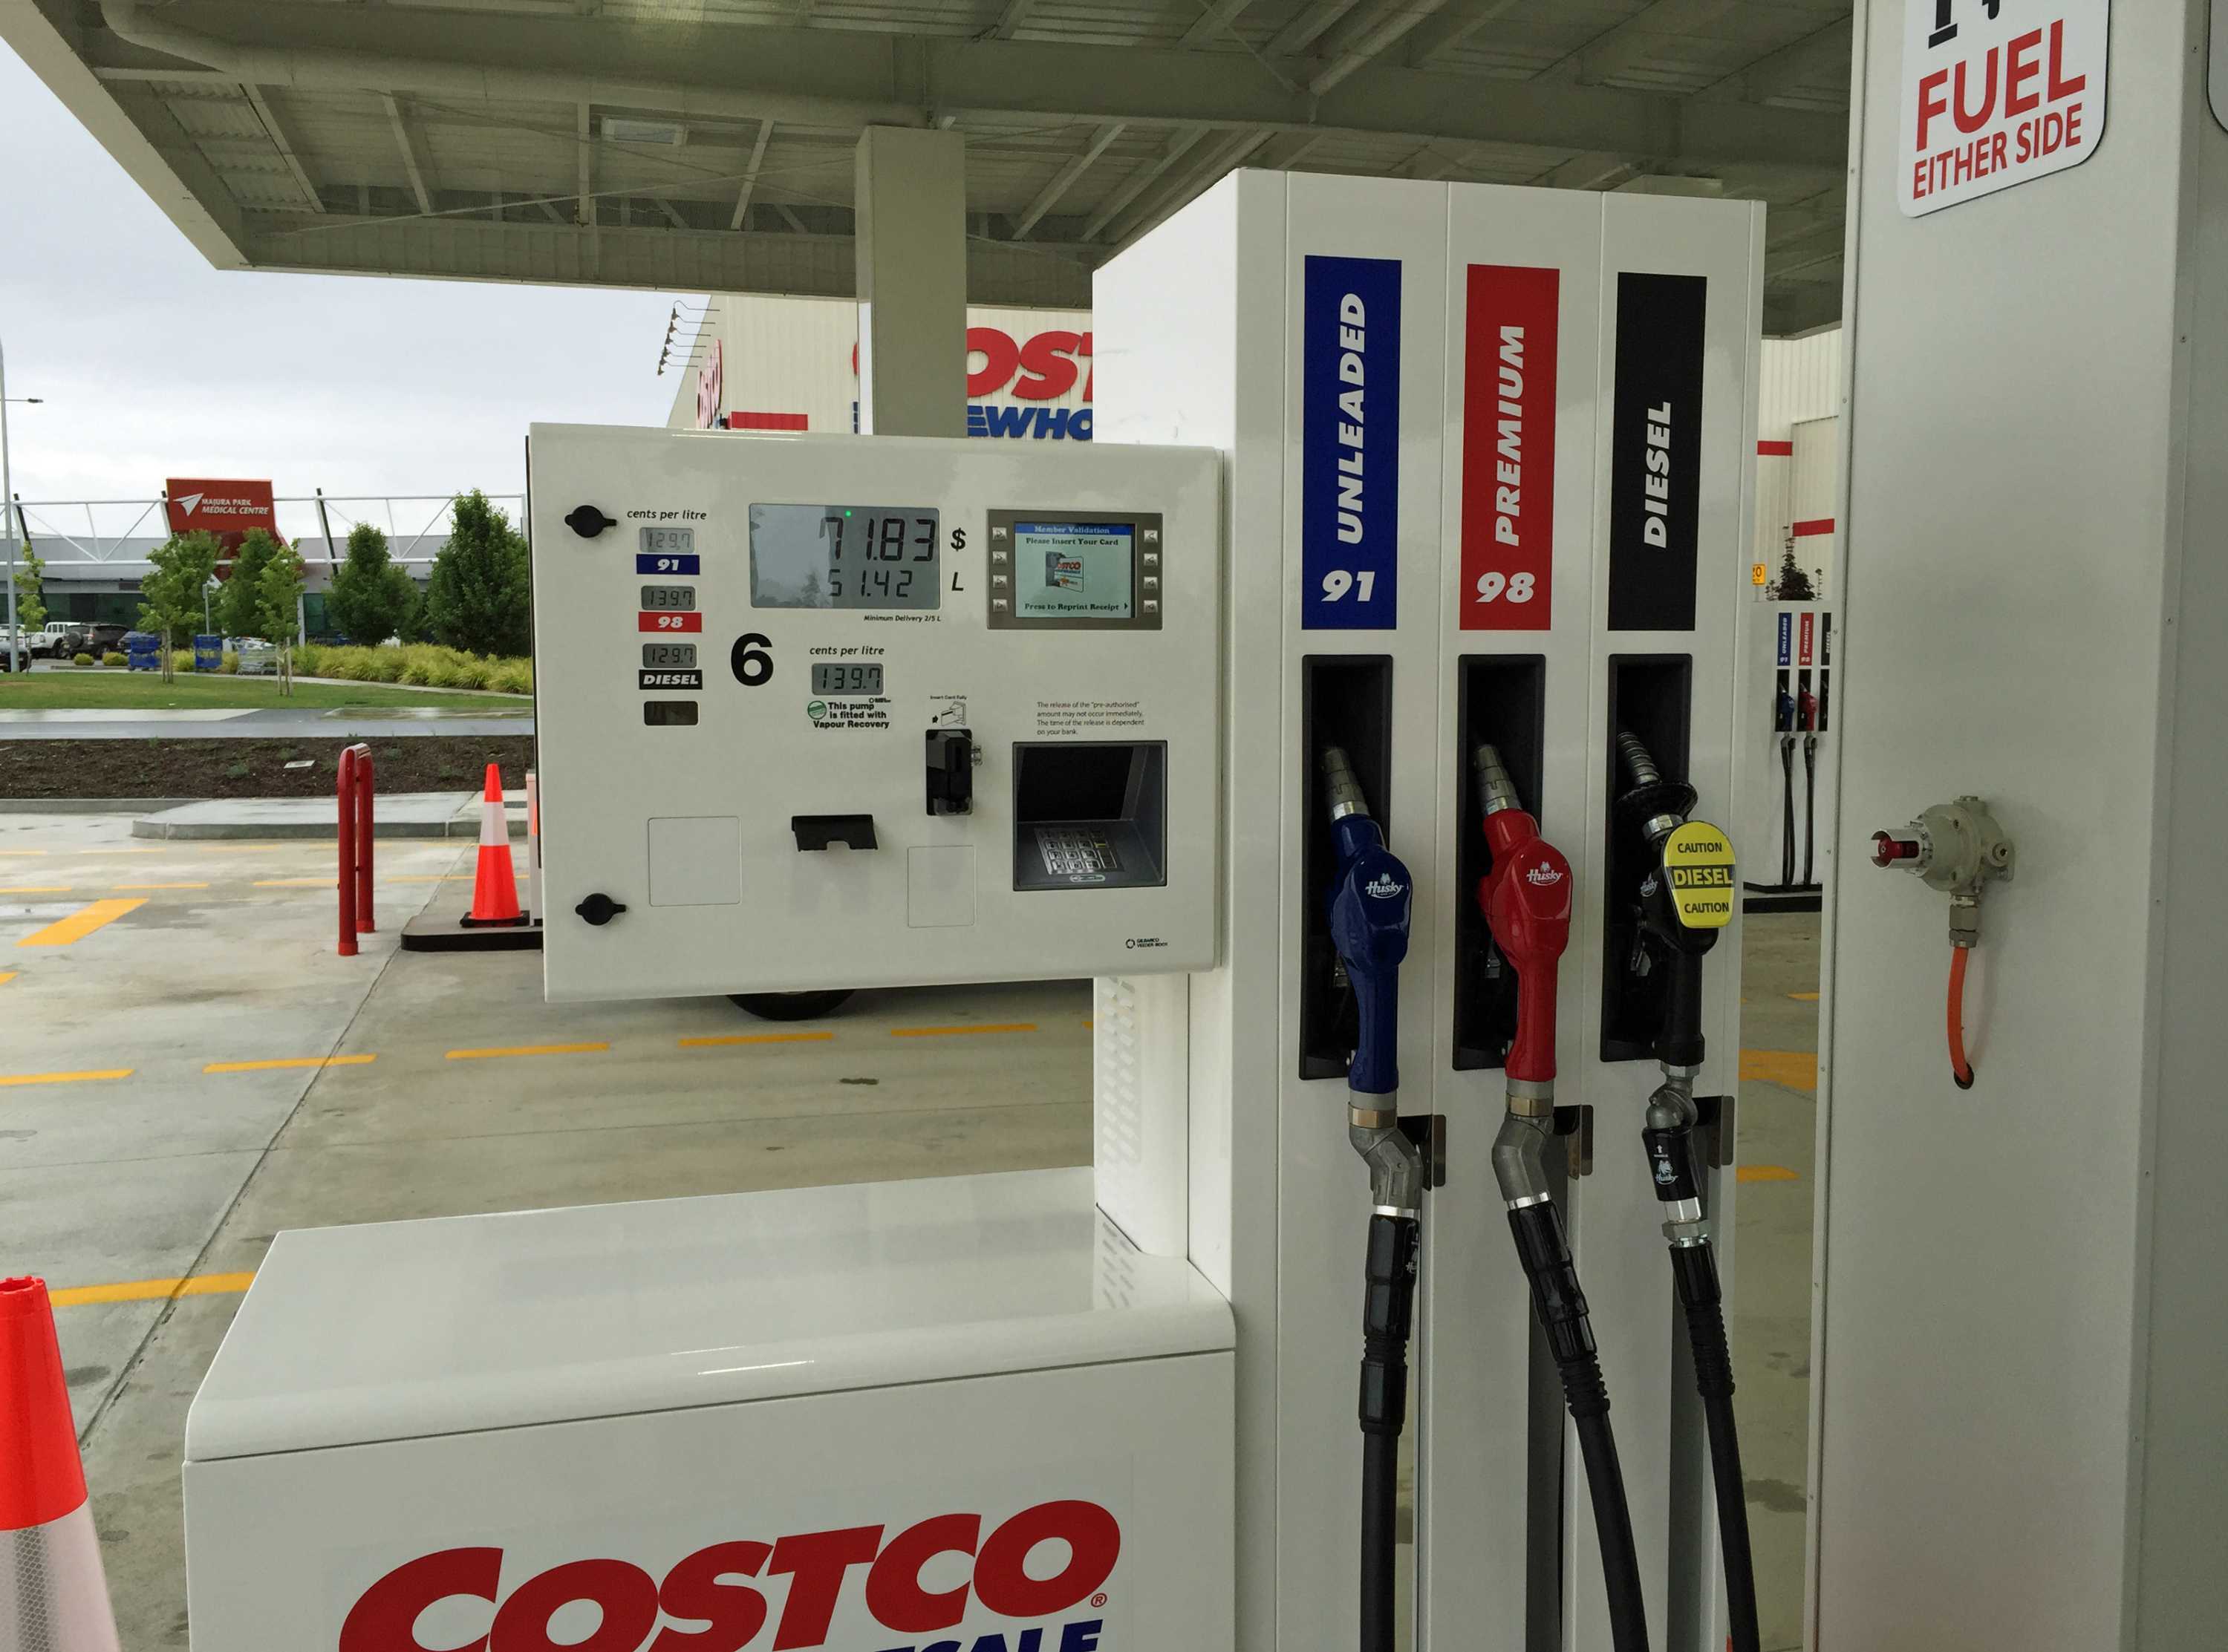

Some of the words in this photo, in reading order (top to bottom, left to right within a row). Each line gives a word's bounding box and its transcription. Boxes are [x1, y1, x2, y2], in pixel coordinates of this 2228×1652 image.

[1916, 19, 2085, 151] FUEL
[1913, 131, 2007, 200] EITHER
[2016, 102, 2082, 163] SIDE
[1338, 293, 1367, 544] UNLEADED
[1495, 325, 1525, 546] PREMIUM
[1644, 402, 1671, 548] DIESEL
[201, 498, 230, 506] MAJURA
[201, 506, 237, 514] MEDICAL
[239, 506, 269, 515] CENTRE
[627, 509, 657, 518] cents
[659, 511, 679, 520] per
[683, 509, 707, 520] litre
[1034, 526, 1066, 534] Member
[1068, 526, 1110, 535] Validation
[950, 527, 966, 552] $
[1026, 537, 1051, 545] Please
[1052, 538, 1075, 546] Insert
[1099, 538, 1118, 546] Card
[657, 558, 680, 571] 91
[951, 572, 964, 591] L
[1320, 569, 1375, 601] 91
[1475, 571, 1535, 603] 98
[651, 590, 692, 607] 139.7
[1024, 603, 1046, 611] Press
[1058, 604, 1088, 613] Reprint
[1089, 604, 1119, 613] Receipt
[658, 616, 683, 628] 98
[895, 615, 922, 623] Delivery
[651, 647, 693, 663] 129.7
[810, 647, 838, 656] cents
[841, 648, 858, 658] per
[861, 646, 885, 656] litre
[731, 633, 774, 686] 6
[643, 675, 698, 685] DIESEL
[822, 667, 881, 690] 139.7
[827, 702, 847, 710] This
[813, 720, 845, 729] Vapour
[847, 720, 890, 729] Recovery
[1677, 842, 1722, 853] CAUTION
[1526, 868, 1563, 882] Husky
[1673, 868, 1733, 886] DIESEL
[1365, 881, 1404, 894] Husky
[1684, 902, 1730, 913] CAUTION
[339, 1500, 1121, 1652] COSTCO
